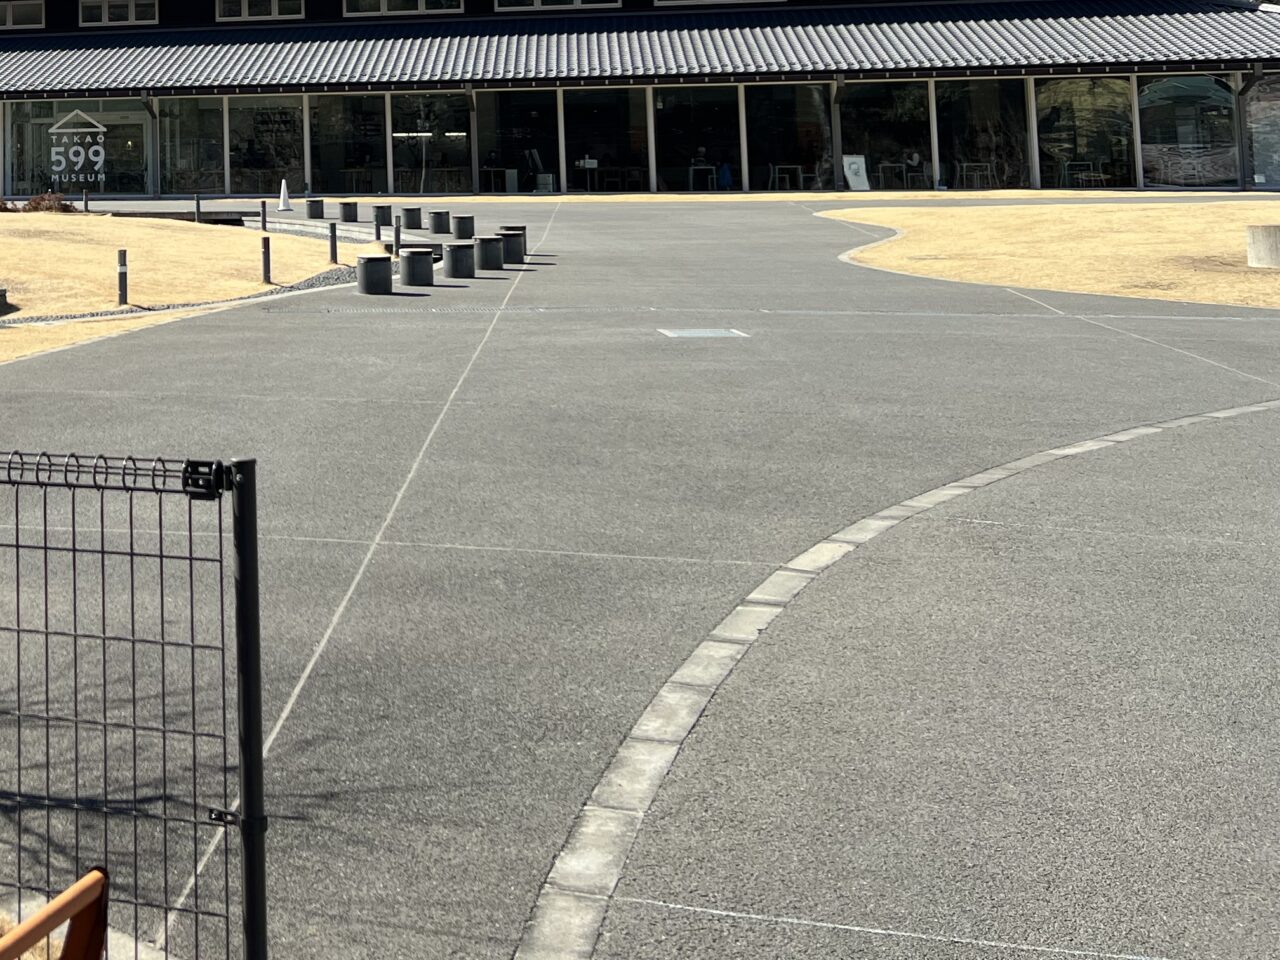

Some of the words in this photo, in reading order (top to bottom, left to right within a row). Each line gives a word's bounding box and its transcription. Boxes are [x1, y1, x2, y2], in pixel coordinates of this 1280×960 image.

[51, 135, 105, 143] TAKAO
[51, 145, 105, 171] 599
[51, 173, 105, 182] MUSEUM
